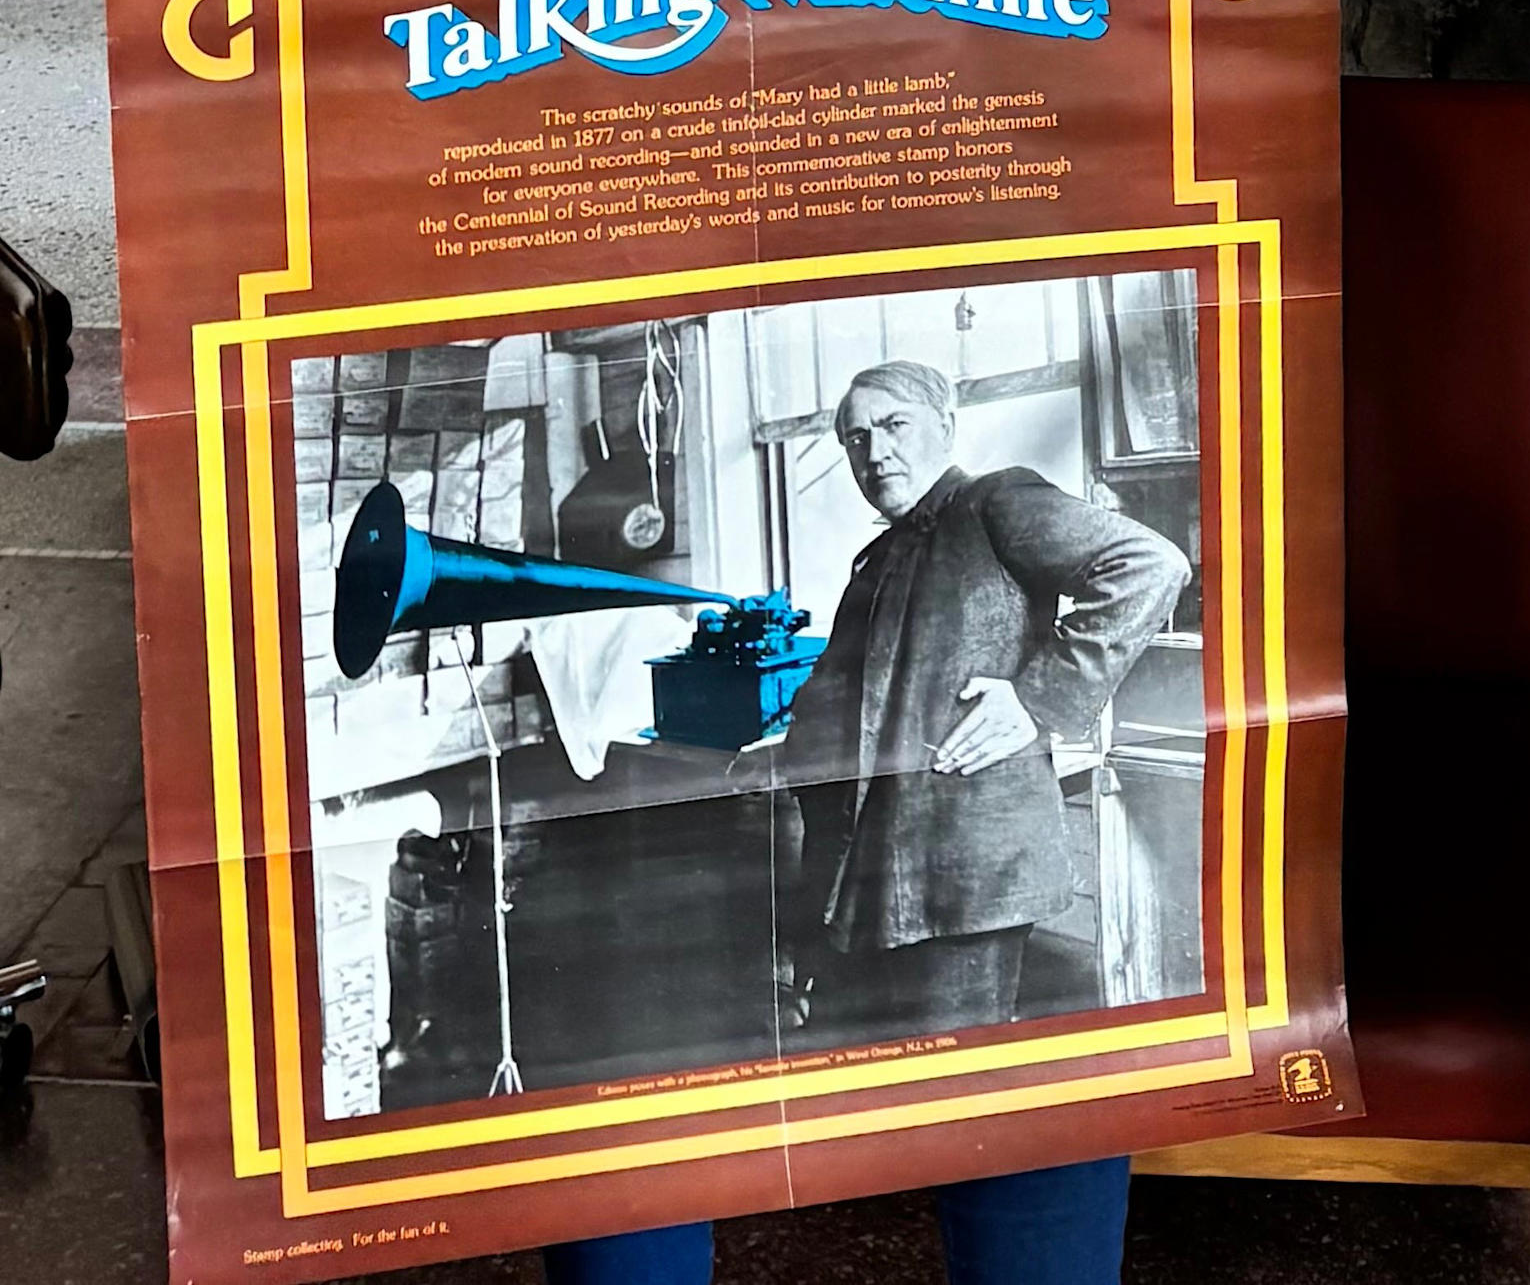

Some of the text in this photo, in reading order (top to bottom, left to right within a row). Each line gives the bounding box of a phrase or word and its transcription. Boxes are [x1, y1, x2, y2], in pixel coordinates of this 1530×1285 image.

[444, 137, 545, 162] reproduced
[551, 134, 566, 149] in
[574, 126, 615, 148] 1877
[621, 127, 644, 142] on
[651, 128, 662, 140] a
[668, 119, 716, 139] crude
[812, 104, 877, 126] cylinder
[883, 99, 946, 118] marked
[952, 94, 978, 111] the
[984, 90, 1046, 112] genesis
[541, 109, 577, 127] The
[583, 102, 656, 125] scratchy
[662, 95, 723, 116] sounds
[730, 92, 748, 109] of
[809, 83, 841, 101] had
[847, 85, 858, 97] a
[864, 78, 898, 96] little
[429, 168, 448, 187] of
[454, 163, 523, 184] modern
[529, 156, 584, 176] sound
[729, 135, 802, 158] sounded
[807, 133, 823, 148] in
[829, 134, 840, 146] a
[846, 127, 881, 144] new
[887, 126, 912, 141] era
[919, 120, 937, 137] of
[941, 113, 1059, 136] enlightenment
[483, 139, 1014, 205] for everyone everywhere. This commemorative stamp honors
[419, 155, 1072, 236] the Centennial of Sound Recording and its contribution to posterity through
[434, 239, 464, 258] the
[469, 229, 578, 257] preservation
[584, 224, 602, 241] of
[708, 207, 761, 228] words
[767, 204, 799, 222] and
[805, 198, 856, 218] music
[861, 194, 886, 212] for
[990, 181, 1061, 202] listening.
[243, 1247, 284, 1265] Stamp
[353, 1232, 374, 1248] For
[378, 1227, 397, 1243] the
[400, 1225, 419, 1240] fun
[423, 1221, 436, 1235] of
